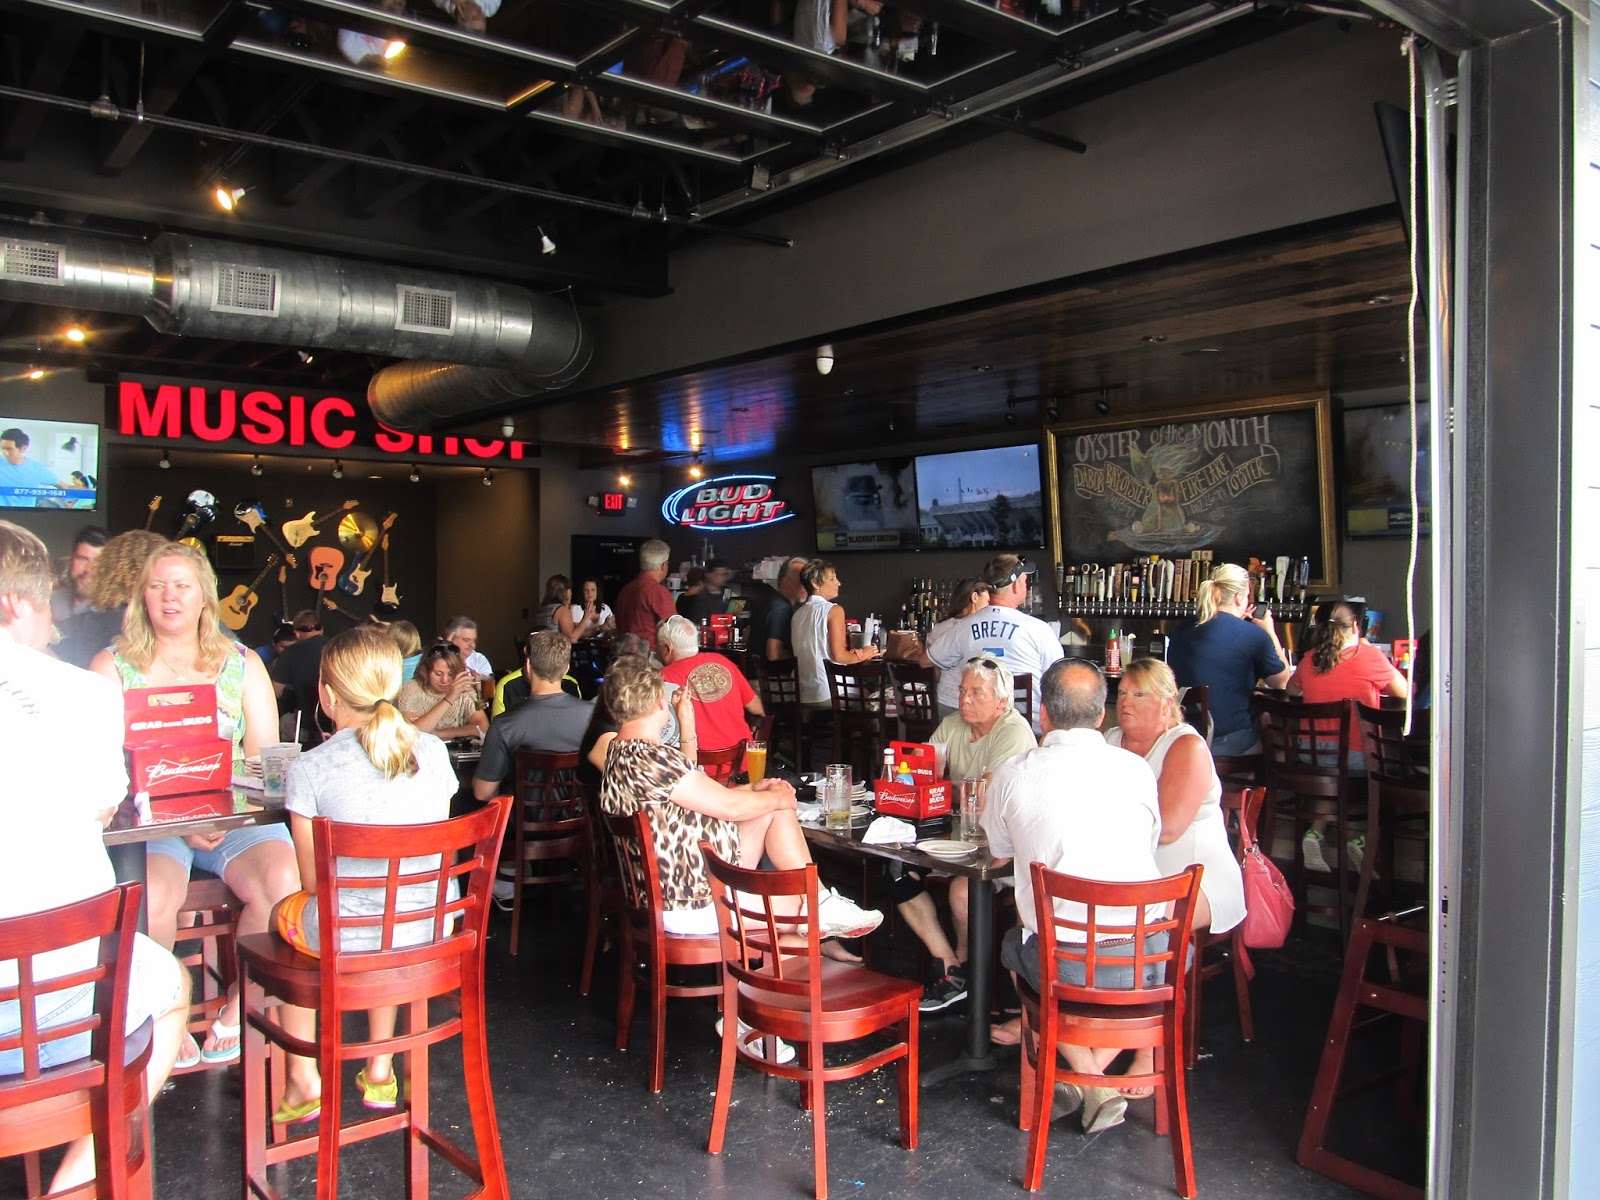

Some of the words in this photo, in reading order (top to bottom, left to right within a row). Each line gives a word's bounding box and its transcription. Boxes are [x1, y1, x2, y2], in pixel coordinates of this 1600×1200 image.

[118, 381, 356, 449] MUSIC
[1075, 430, 1141, 462] OYSTER
[1192, 414, 1270, 455] MONTH
[1229, 458, 1272, 492] OYSTER
[604, 493, 624, 510] EXIT
[694, 483, 773, 508] BUD
[680, 500, 786, 526] LIGHT
[971, 620, 1020, 641] BRETT
[130, 720, 163, 731] GRAB
[182, 715, 213, 727] BUDS
[145, 761, 222, 779] Budweiser
[878, 791, 916, 804] Budweiser
[929, 786, 945, 795] GRAB
[929, 796, 945, 804] BUDS
